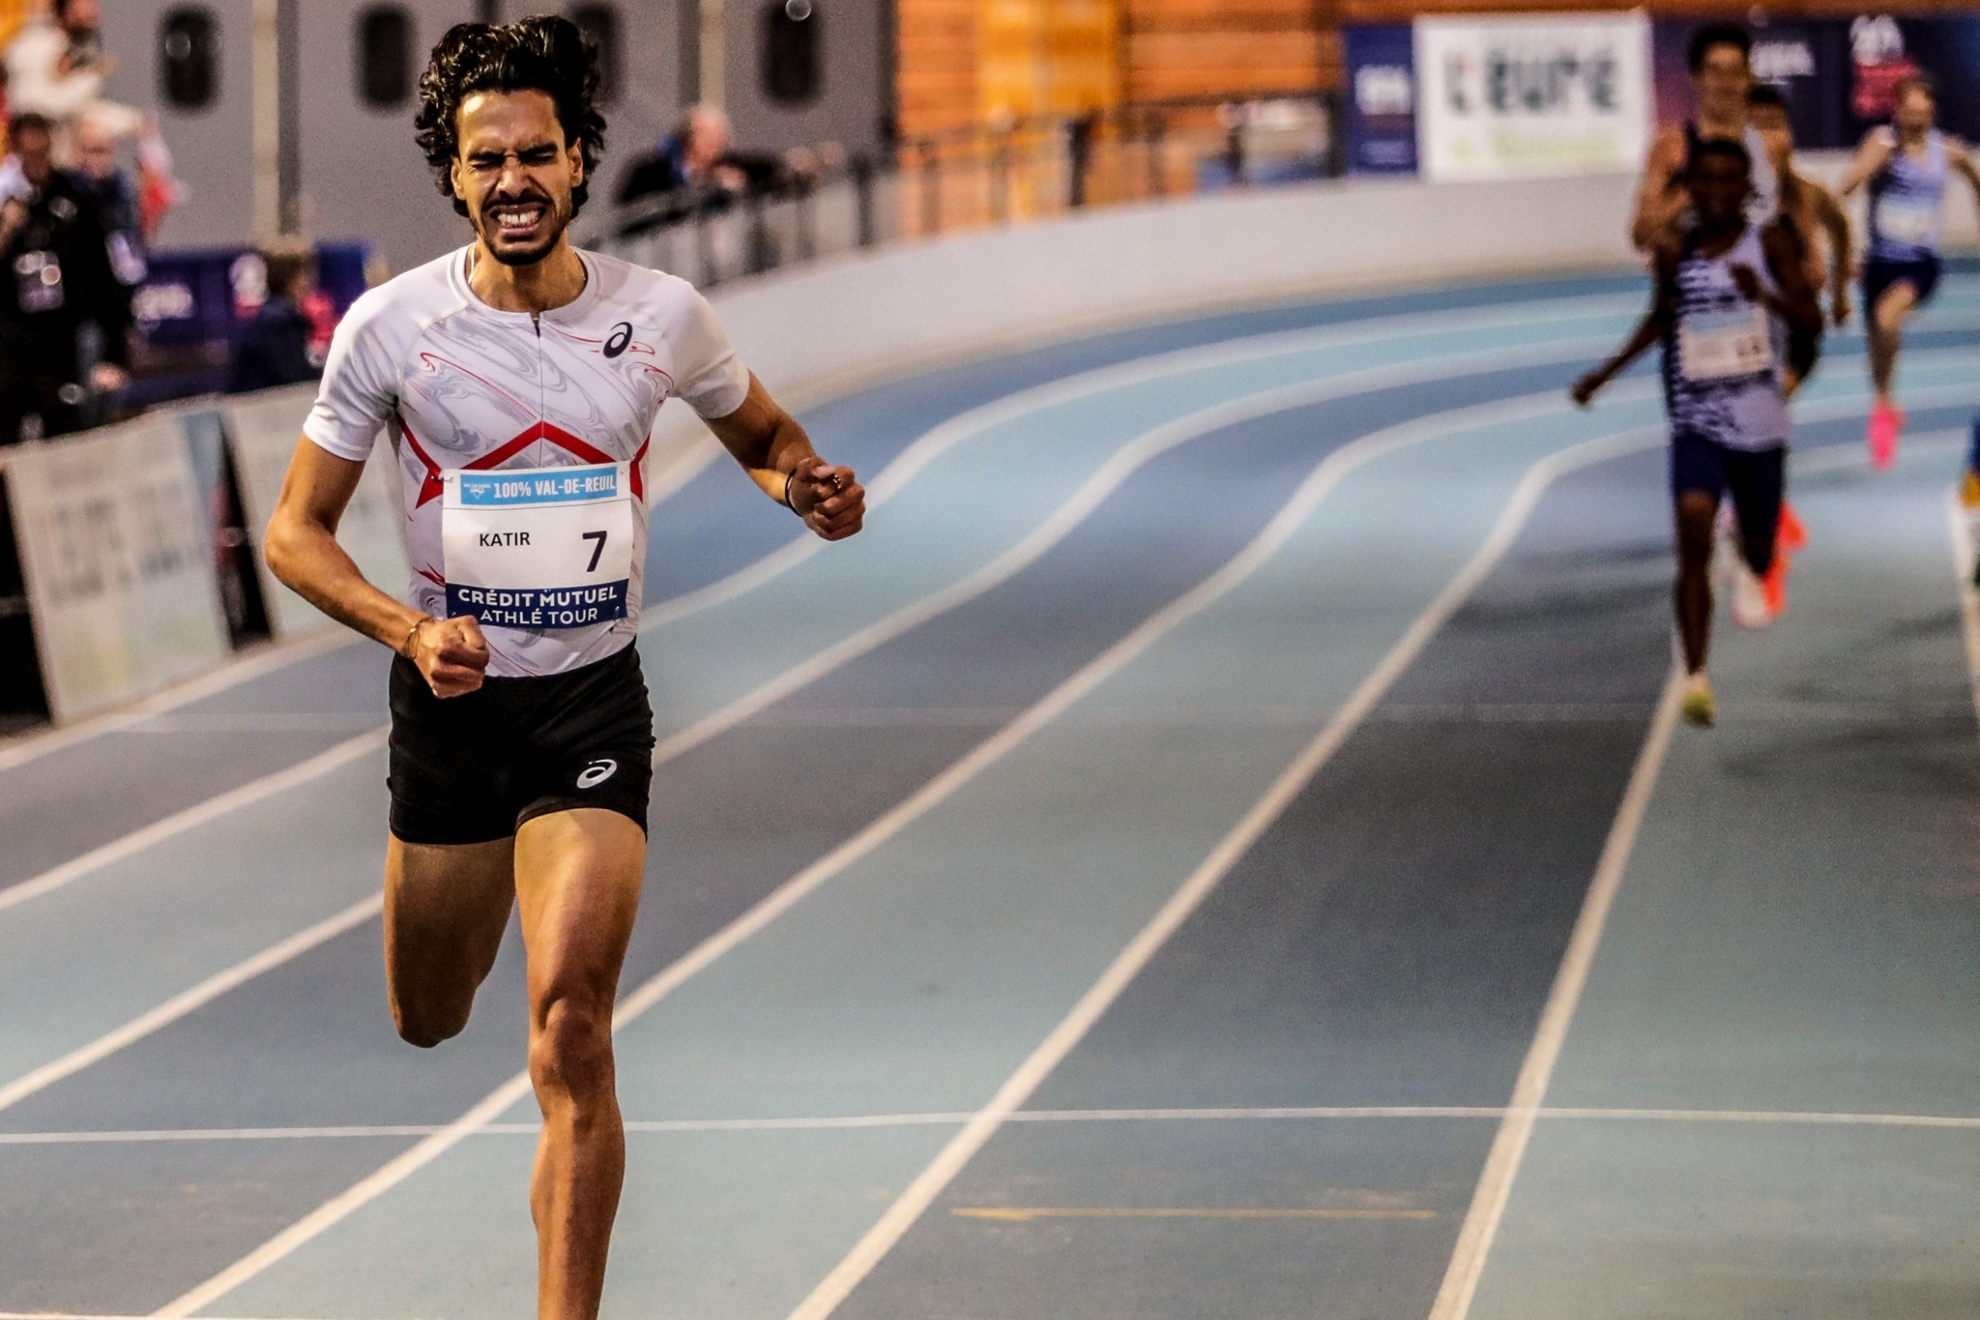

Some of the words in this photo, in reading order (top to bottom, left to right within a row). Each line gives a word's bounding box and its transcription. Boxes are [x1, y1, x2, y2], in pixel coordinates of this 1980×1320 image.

[493, 481, 532, 499] 100%
[535, 475, 616, 497] VAL-DE-REUIL
[479, 531, 531, 547] KATIR
[582, 530, 608, 573] 7
[457, 588, 534, 608] CRÉDIT
[540, 586, 618, 607] MUTUEL
[480, 608, 543, 625] ATHLÉ
[548, 607, 598, 625] TOUR
